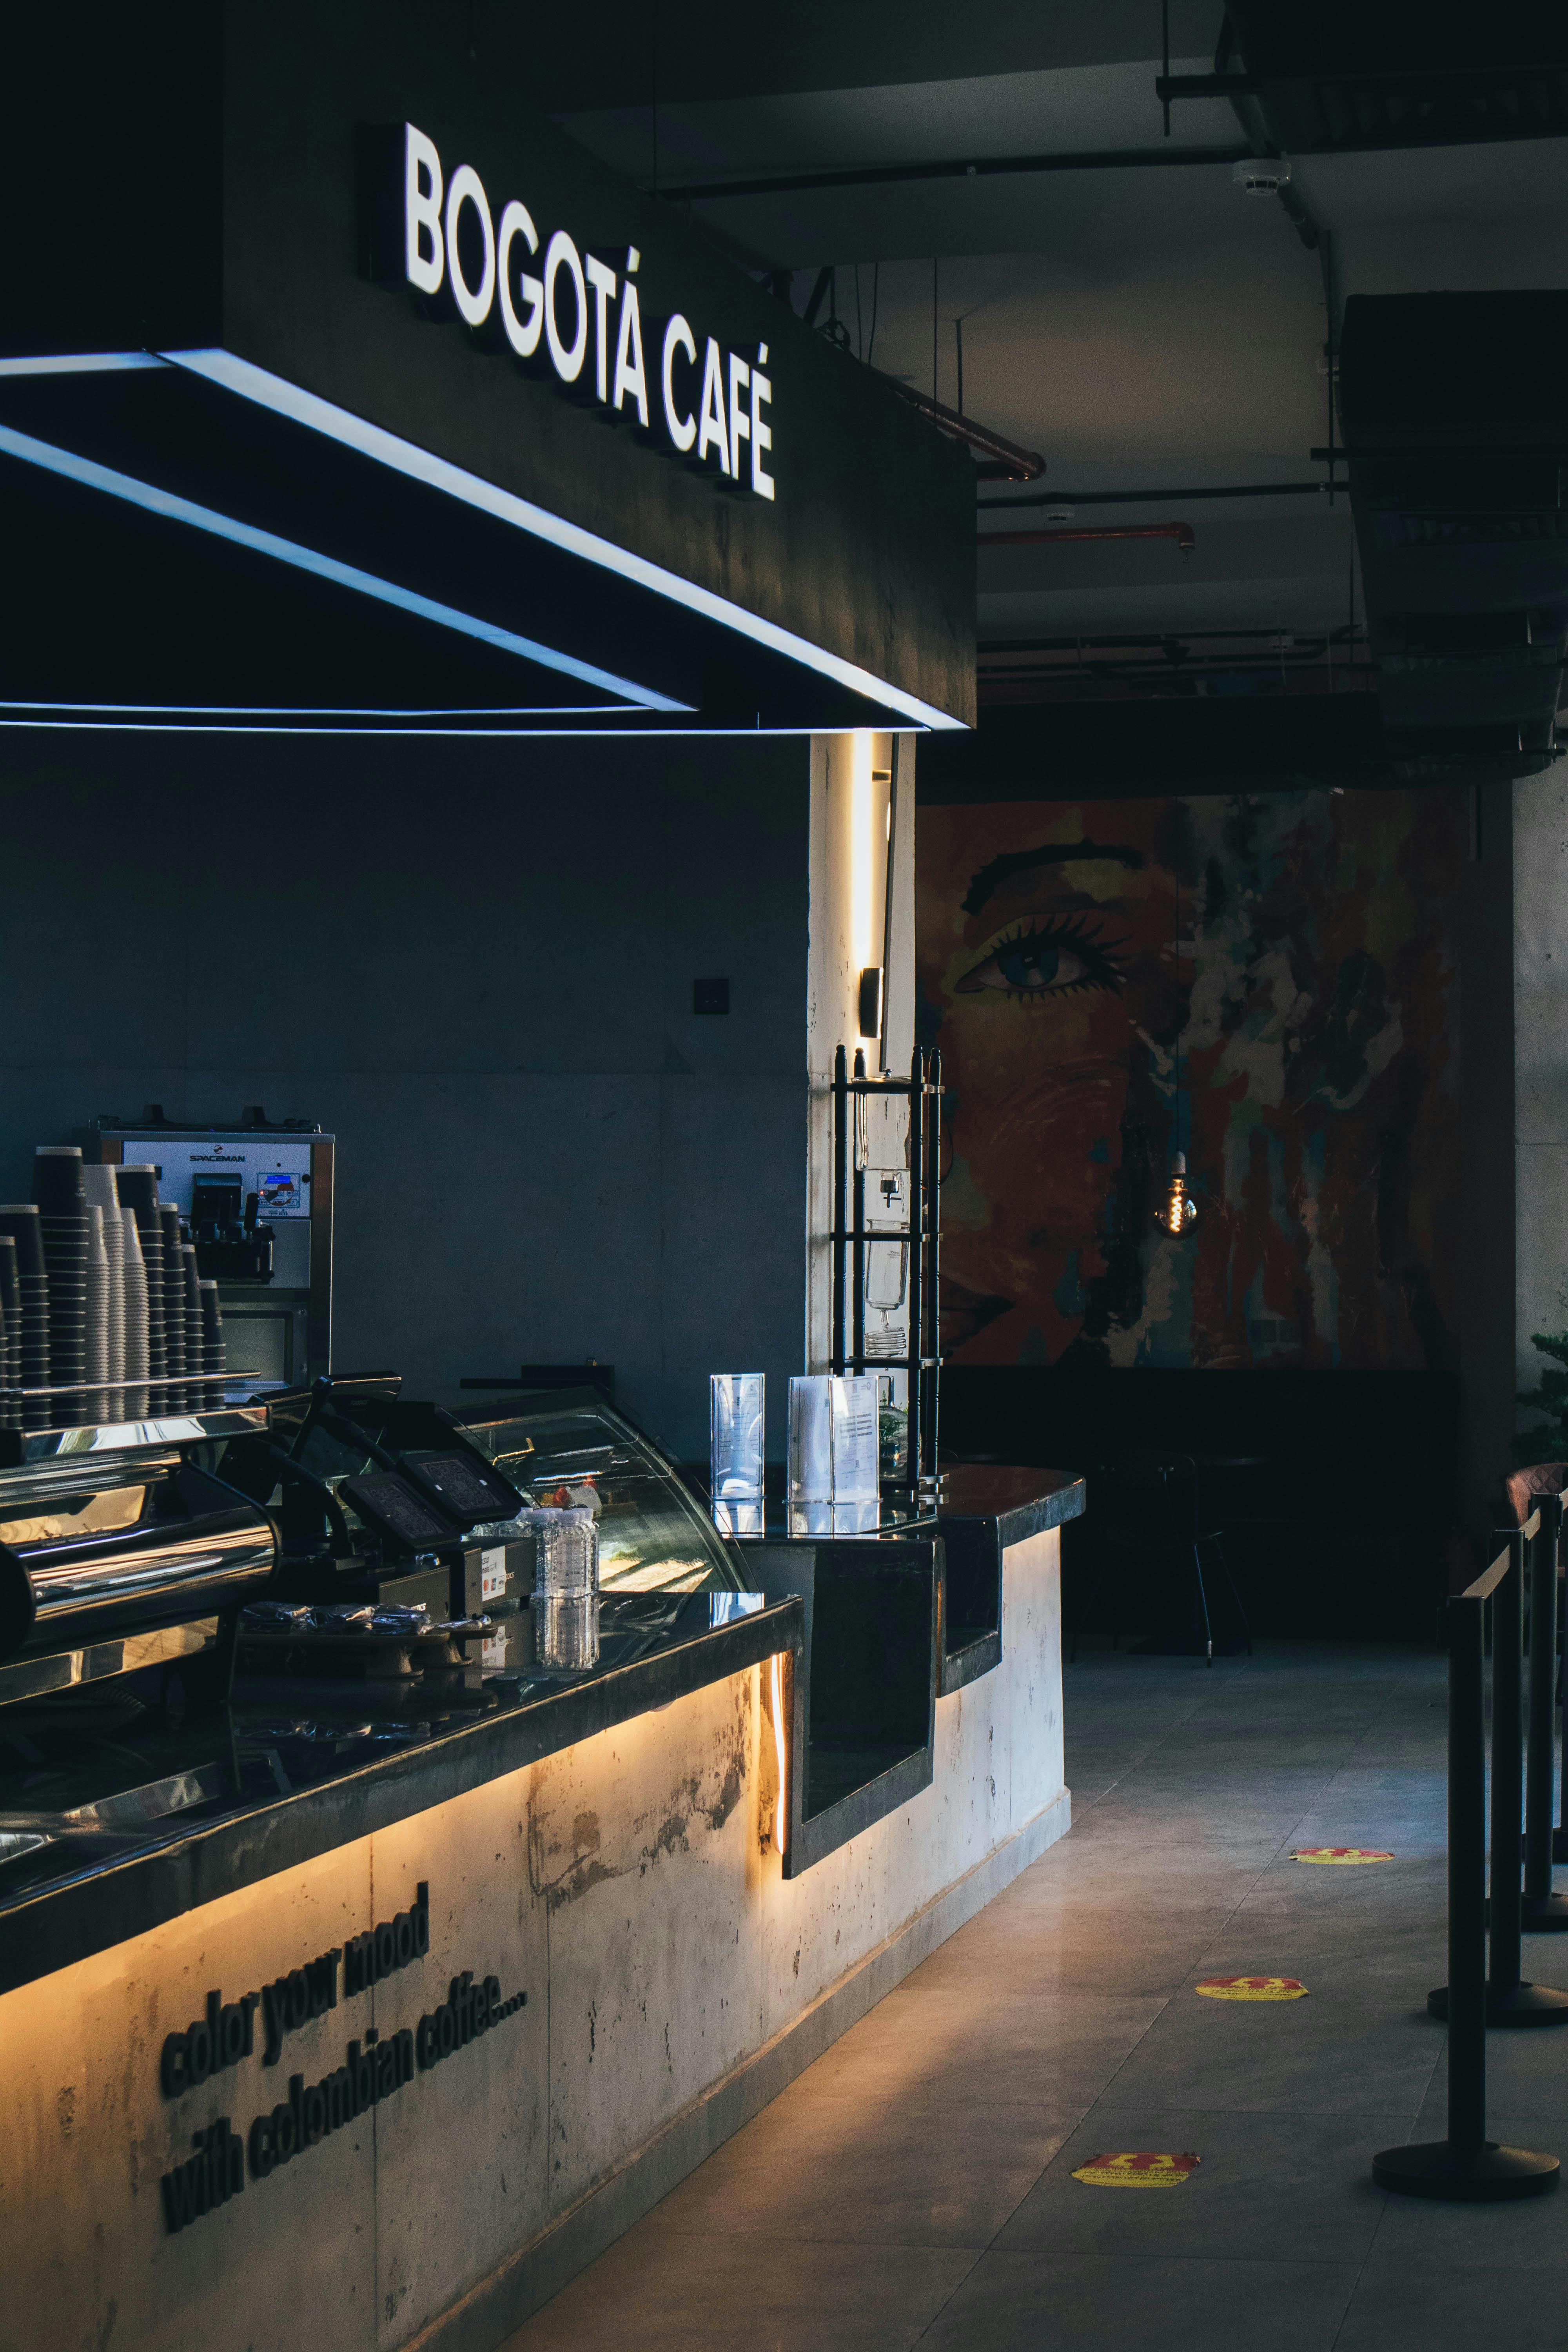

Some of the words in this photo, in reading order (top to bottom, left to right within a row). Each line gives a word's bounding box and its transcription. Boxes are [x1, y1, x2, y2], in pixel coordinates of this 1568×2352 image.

[406, 122, 649, 427] BOGOTÁ
[662, 314, 775, 501] CAFÉ
[161, 1990, 259, 2097] color
[262, 1947, 342, 2067] your
[344, 1881, 429, 1997] mood
[161, 2117, 244, 2233] with
[249, 2029, 414, 2178] colombian
